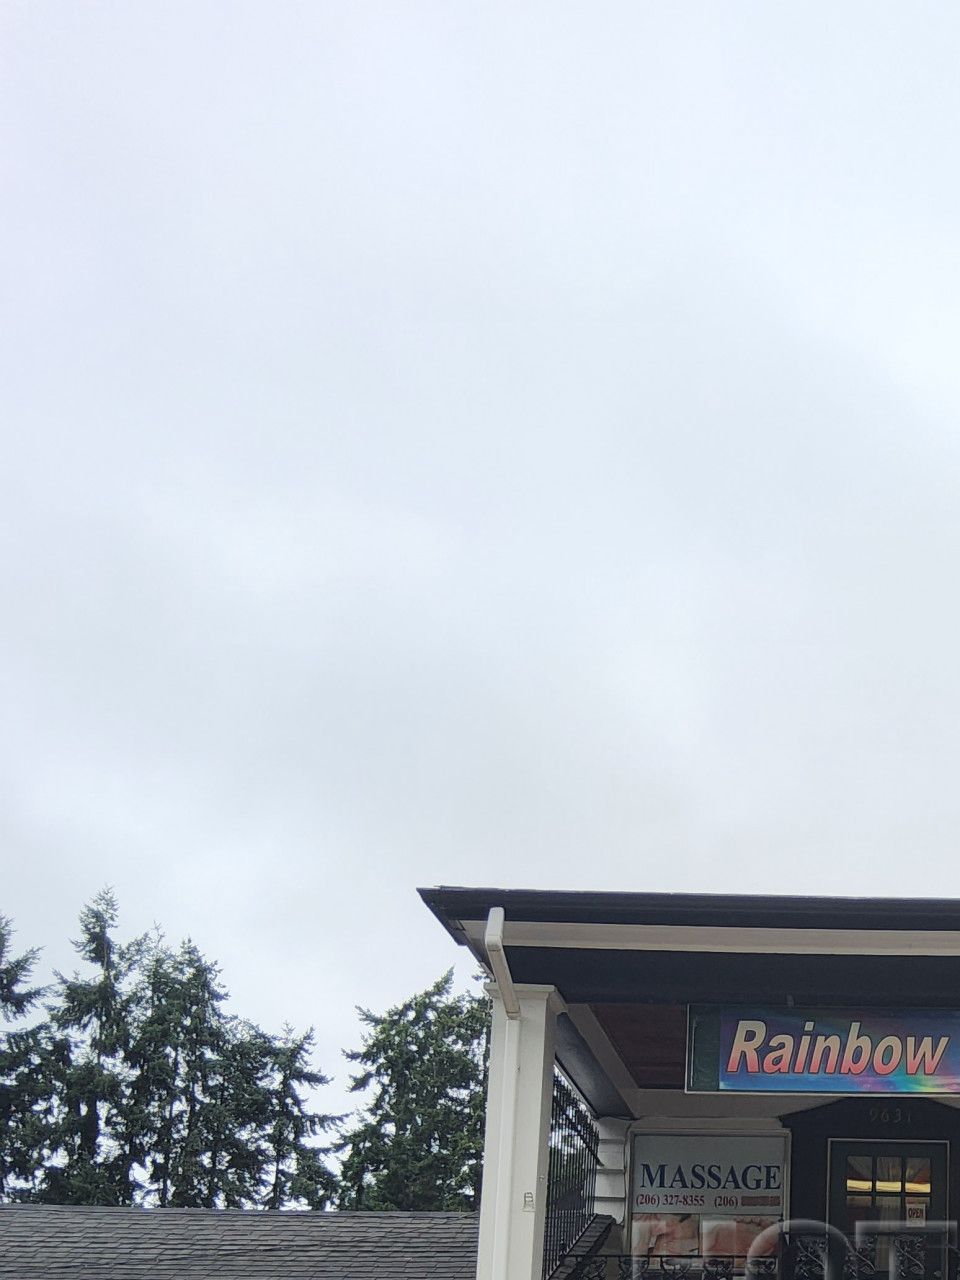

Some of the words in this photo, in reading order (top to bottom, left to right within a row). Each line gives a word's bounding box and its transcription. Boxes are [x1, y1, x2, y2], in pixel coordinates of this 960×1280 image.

[726, 1020, 949, 1076] Rainbow
[640, 1163, 781, 1190] MASSAGE
[636, 1194, 659, 1207] (206)
[714, 1196, 738, 1209] (206)
[908, 1208, 923, 1218] OPEN
